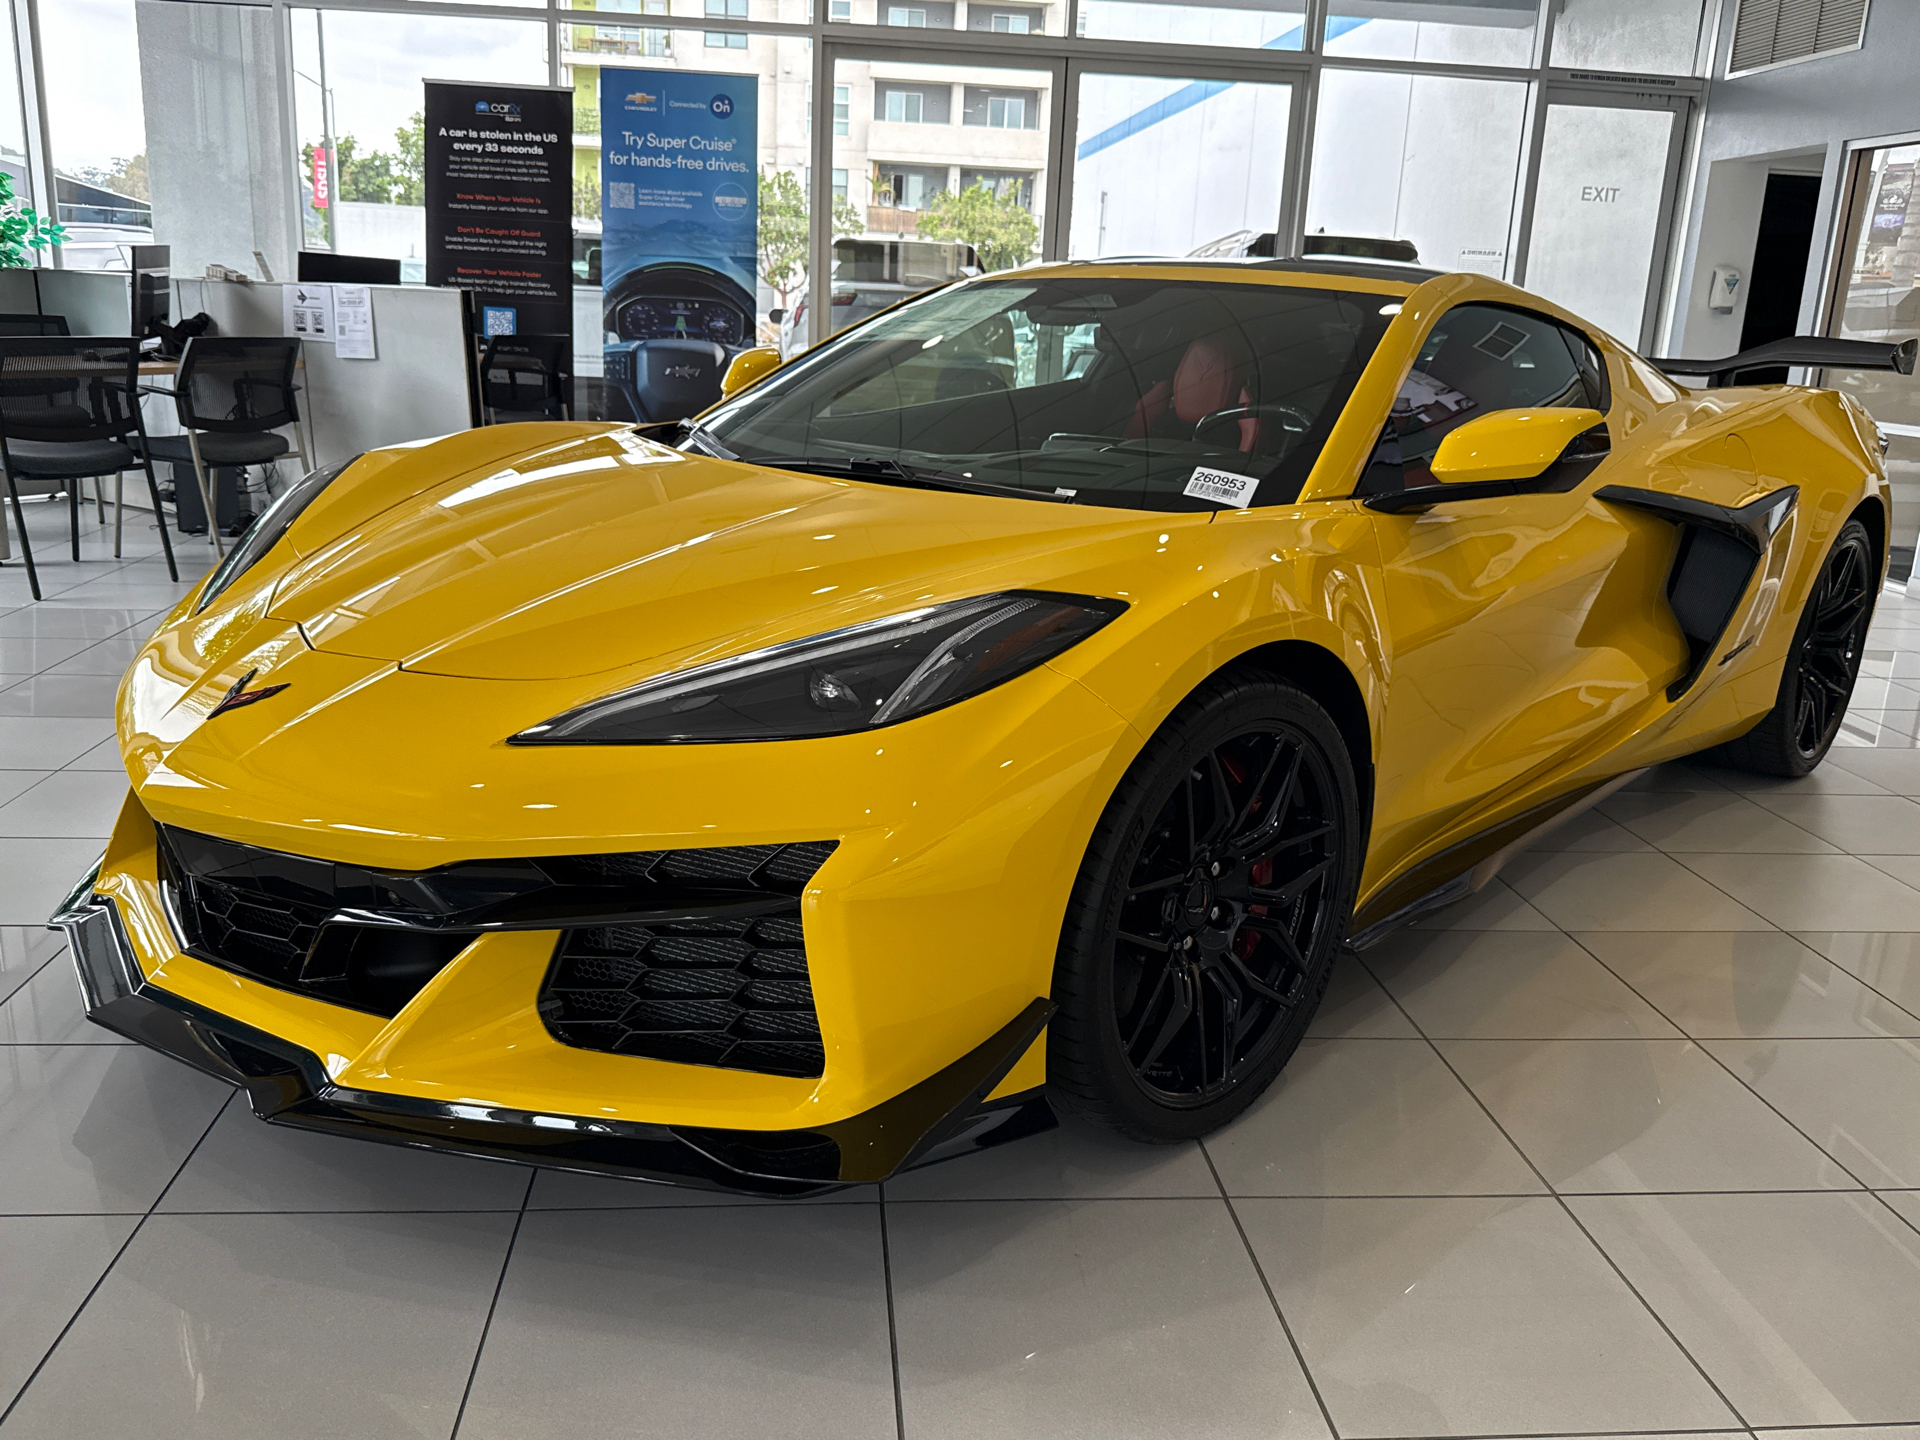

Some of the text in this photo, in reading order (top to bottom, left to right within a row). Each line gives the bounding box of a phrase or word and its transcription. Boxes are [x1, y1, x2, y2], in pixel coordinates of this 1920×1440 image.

[439, 128, 558, 143] A car is stolen in the US
[622, 131, 644, 149] Try
[647, 132, 687, 150] Super
[453, 142, 543, 155] every 33 seconds
[609, 151, 749, 173] for hands-free drives.
[512, 196, 534, 204] Vehicle
[1581, 186, 1620, 203] EXIT
[485, 228, 508, 236] Caught
[499, 269, 521, 277] Vehicle
[1194, 472, 1246, 490] 260953
